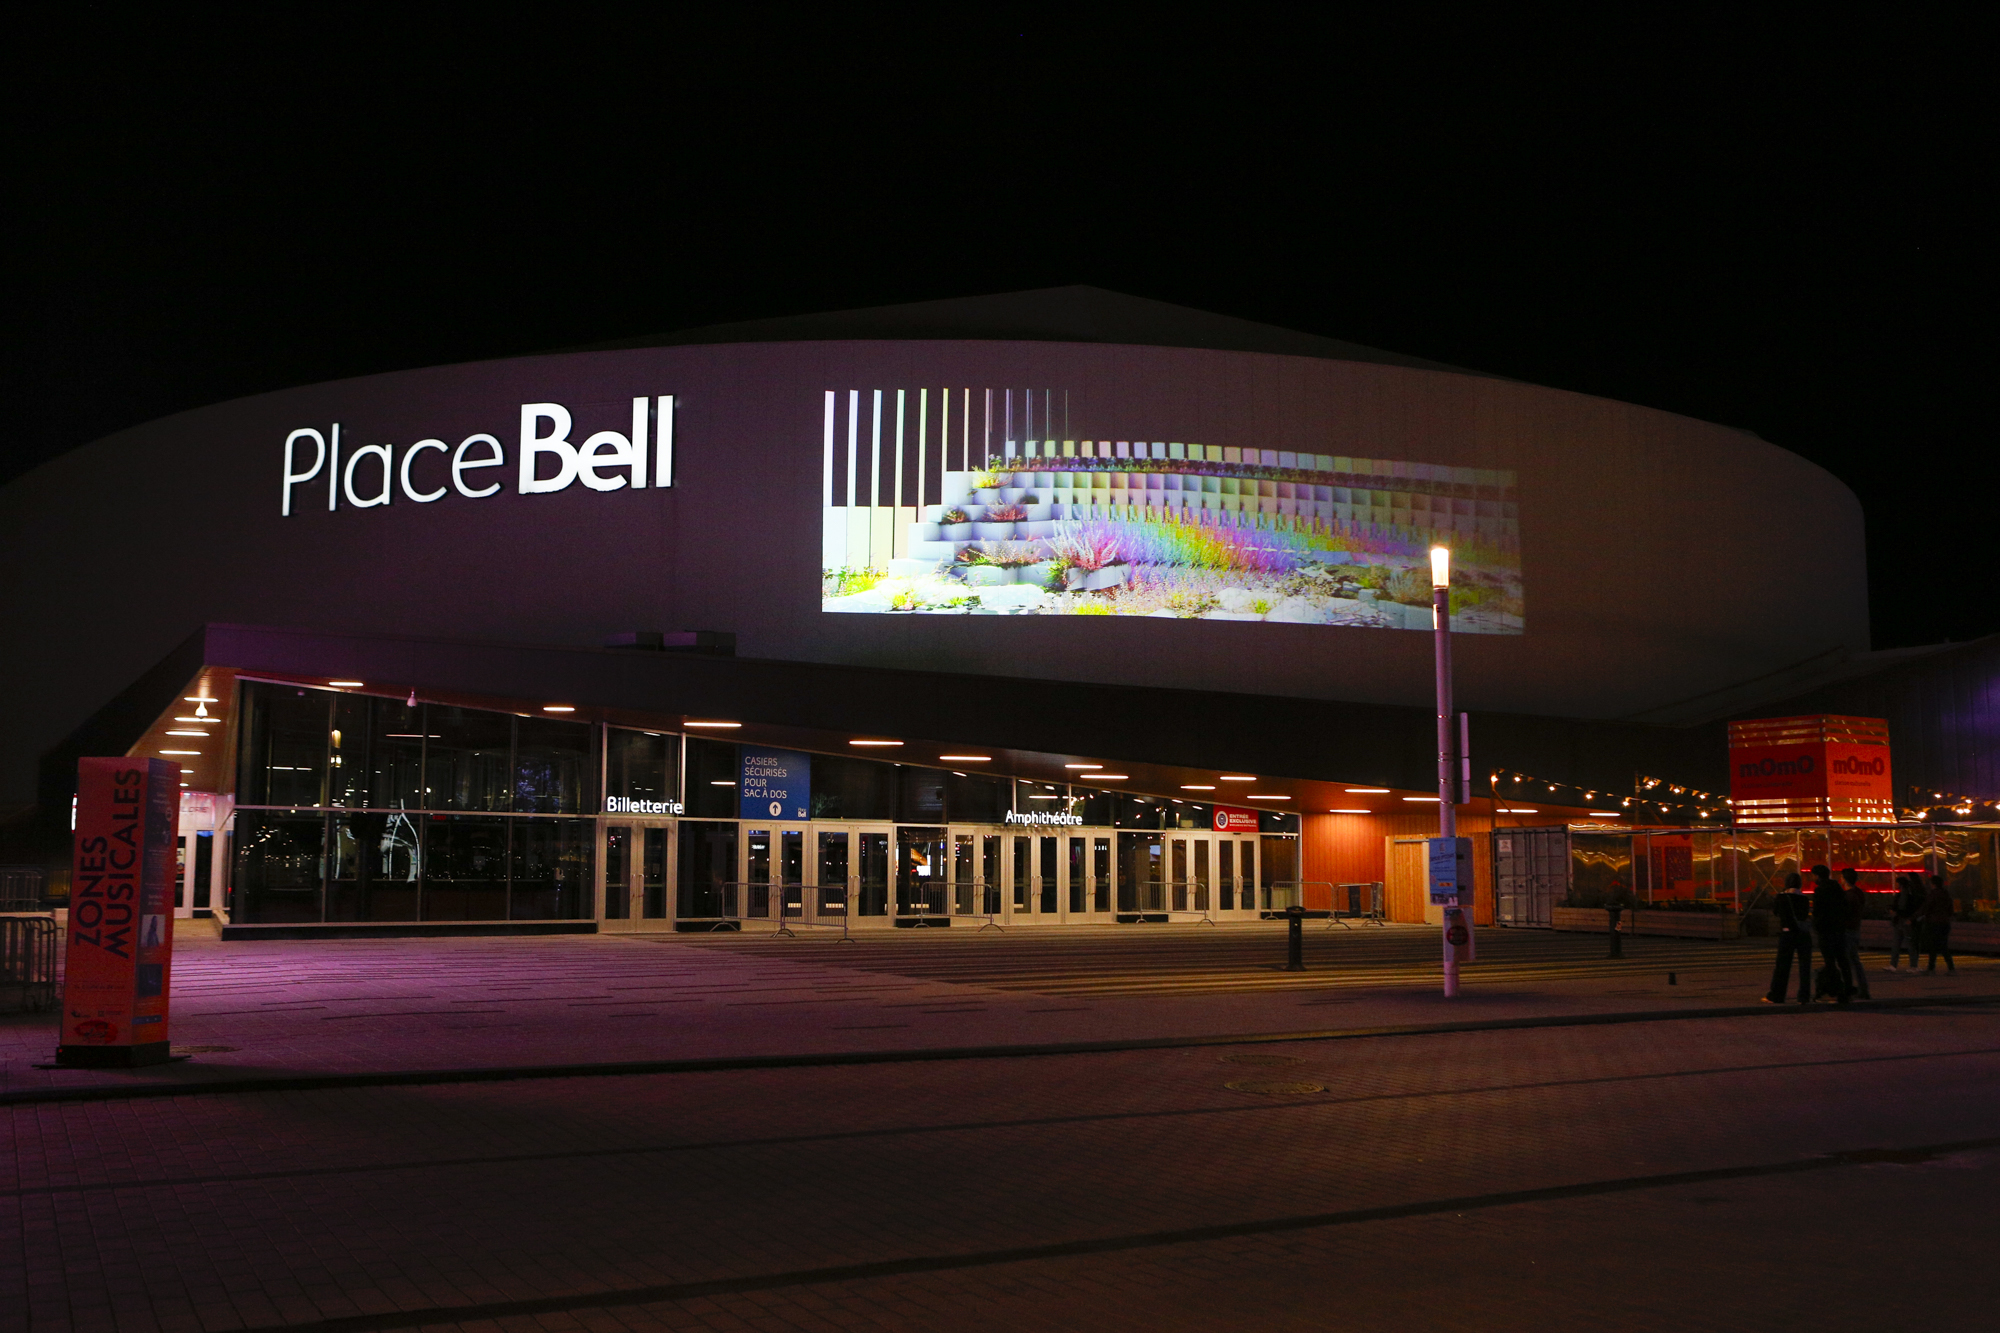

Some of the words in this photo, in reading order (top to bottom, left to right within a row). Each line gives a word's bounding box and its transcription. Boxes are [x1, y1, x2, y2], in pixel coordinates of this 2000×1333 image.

[282, 423, 504, 516] Place
[518, 395, 674, 495] Bell
[744, 756, 778, 766] CASIERS
[744, 766, 788, 778] SÉCURISÉS
[744, 778, 767, 787] POUR
[744, 789, 761, 799] SAC
[762, 787, 769, 799] À
[770, 790, 788, 799] DOS
[606, 796, 683, 814] Billetterie
[1005, 809, 1083, 826] Amphithéâtre
[103, 768, 141, 959] MUSICALES
[75, 836, 107, 947] ZONES
